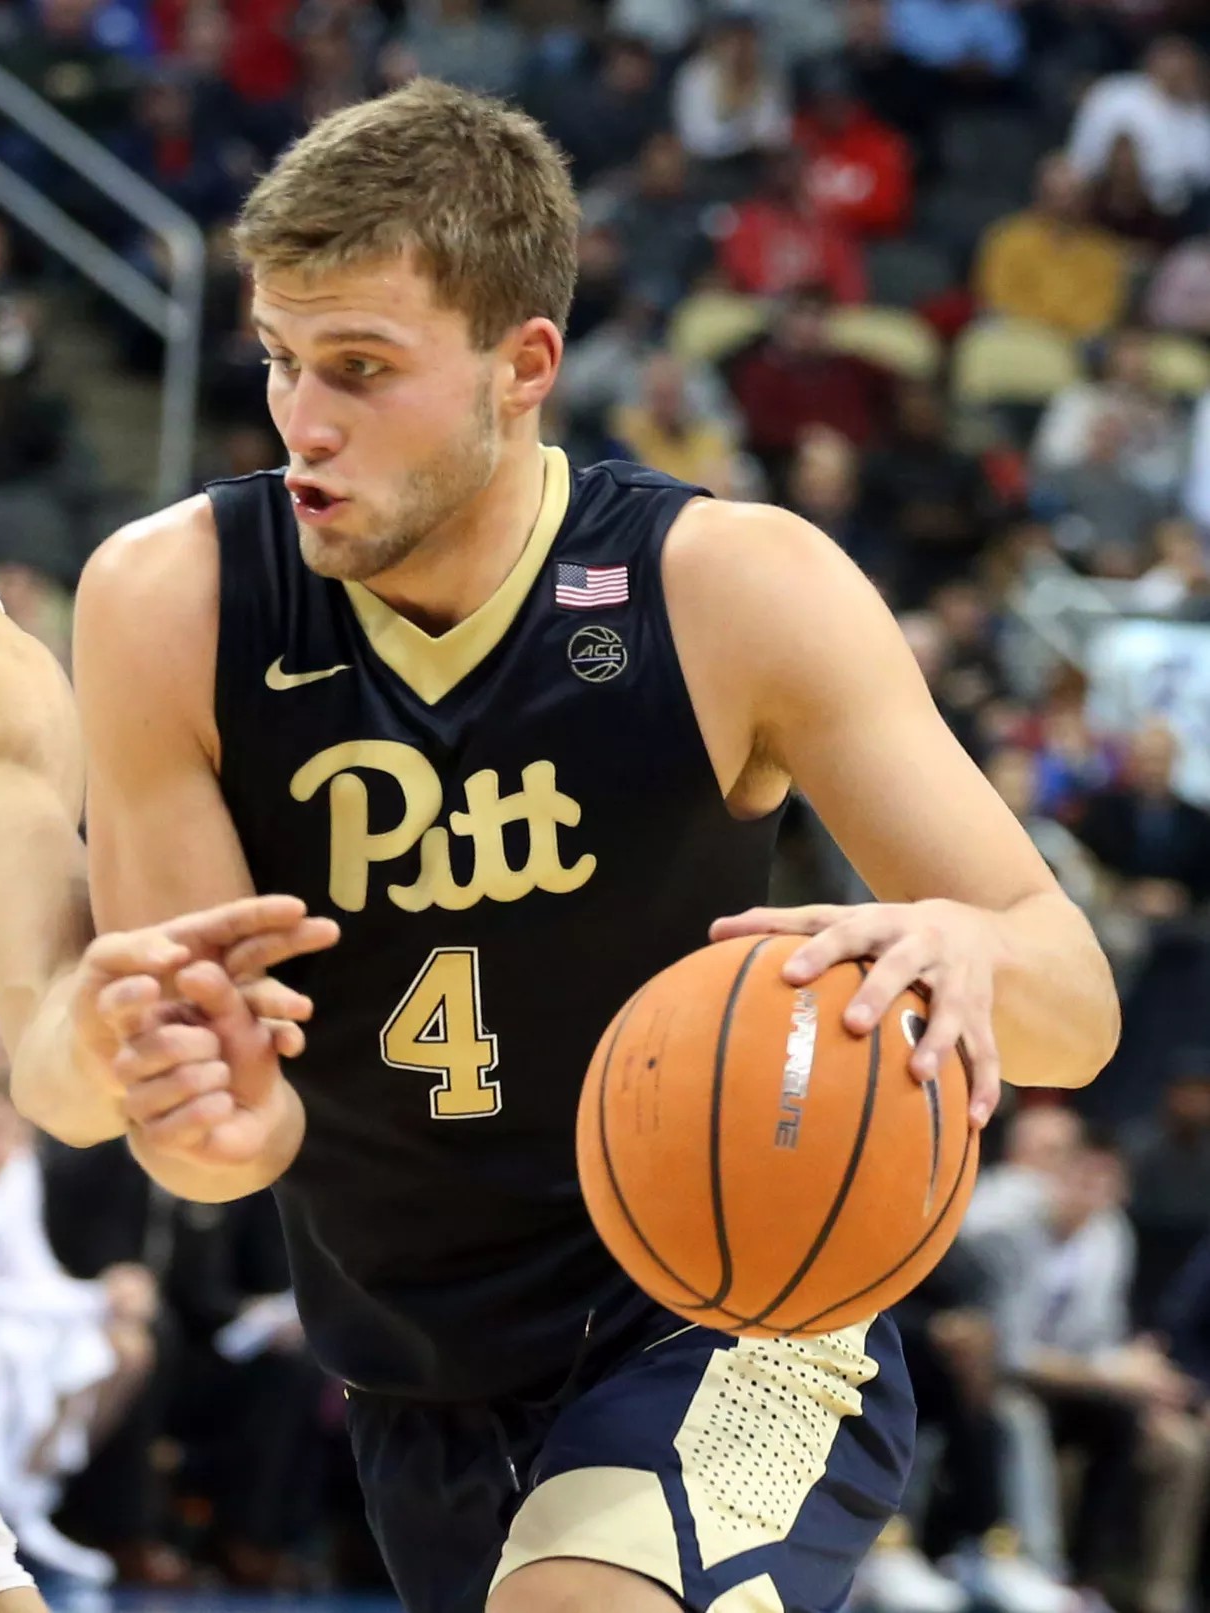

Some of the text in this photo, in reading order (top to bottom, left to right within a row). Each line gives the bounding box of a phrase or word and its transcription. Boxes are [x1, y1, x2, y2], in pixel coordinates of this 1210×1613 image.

[576, 643, 623, 658] ACC
[290, 739, 597, 912] Pitt
[379, 946, 502, 1119] 4
